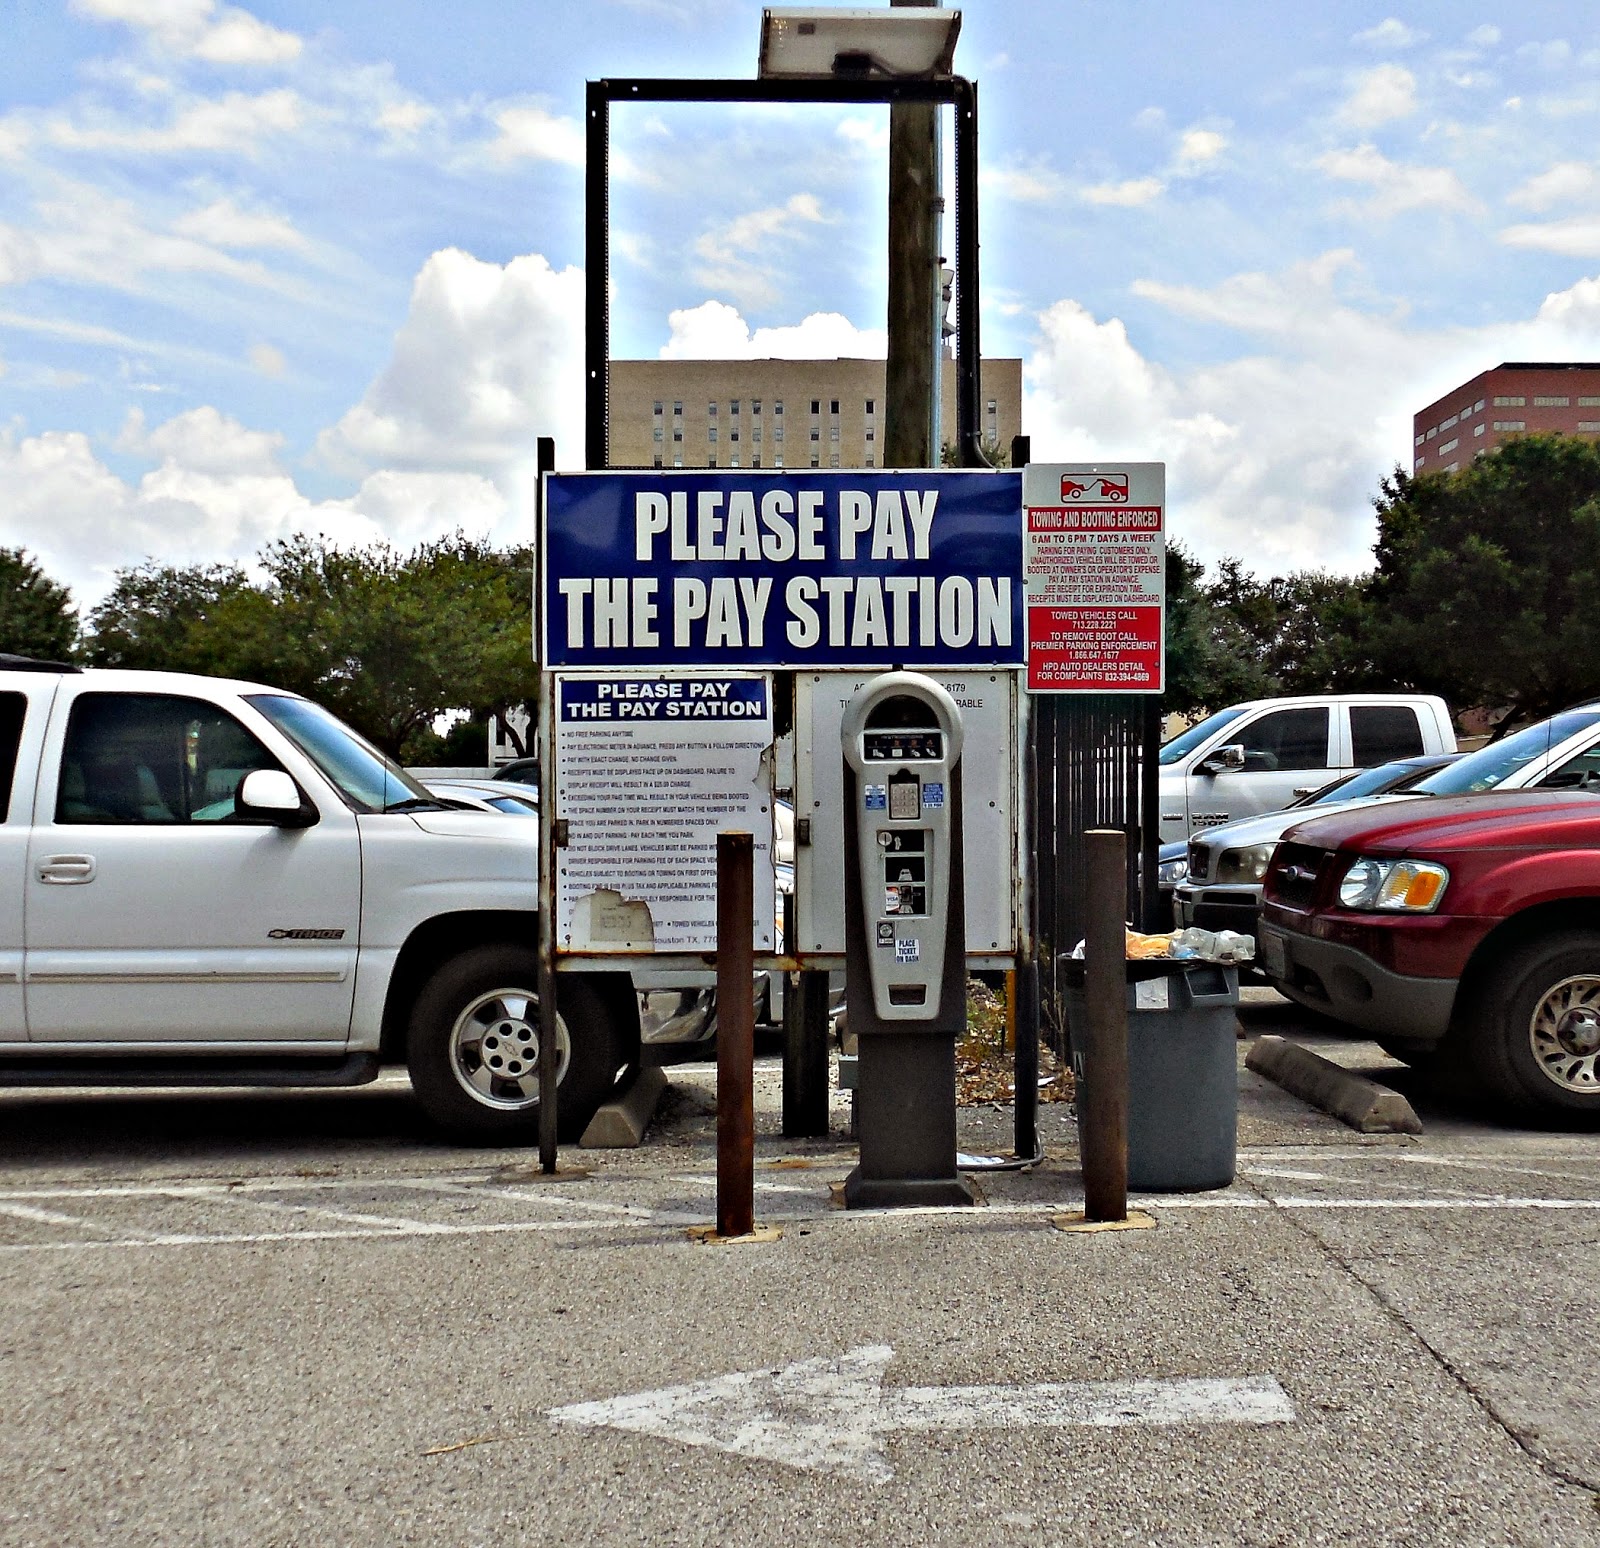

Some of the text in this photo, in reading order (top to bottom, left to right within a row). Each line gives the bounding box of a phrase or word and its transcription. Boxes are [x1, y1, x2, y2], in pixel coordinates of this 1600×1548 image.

[1032, 512, 1157, 527] TOWING AND BOOTING ENFORCED
[636, 490, 939, 561] PLEASE PAY
[1032, 534, 1155, 543] 6 AM TO 6 PM 7 DAYS A WEEK
[1038, 547, 1062, 555] PARKING
[1064, 547, 1075, 555] FOR
[1077, 547, 1096, 555] PAYING
[1100, 547, 1134, 555] CUSTOMERS
[1031, 556, 1157, 564] UNAUTHORIZED VEHICLES WILL BE TOWED OR
[1028, 566, 1050, 574] BOOTED
[1052, 566, 1059, 574] AT
[1088, 566, 1095, 574] OR
[1045, 585, 1056, 593] SEE
[1058, 585, 1080, 593] RECEIPT
[1083, 585, 1093, 593] FOR
[1096, 585, 1128, 593] EXPIRATION
[1028, 595, 1159, 603] RECEIPTS MUST BE DISPLAYED ON DASHBOARD
[559, 576, 1011, 648] THE PAY STATION
[1051, 612, 1137, 620] TOWED VEHICLES CALL
[1073, 621, 1116, 629] 713.228.2221
[1031, 642, 1157, 650] PREMIER PARKING ENFORCEMENT
[1043, 662, 1145, 671] HPD AUTO DEALERS DETAIL
[1037, 672, 1052, 680] FOR
[1055, 672, 1102, 680] COMPLAINTS
[598, 683, 731, 698] PLEASE PAY
[567, 701, 761, 717] THE PAY STATION
[292, 930, 344, 939] TAHOE
